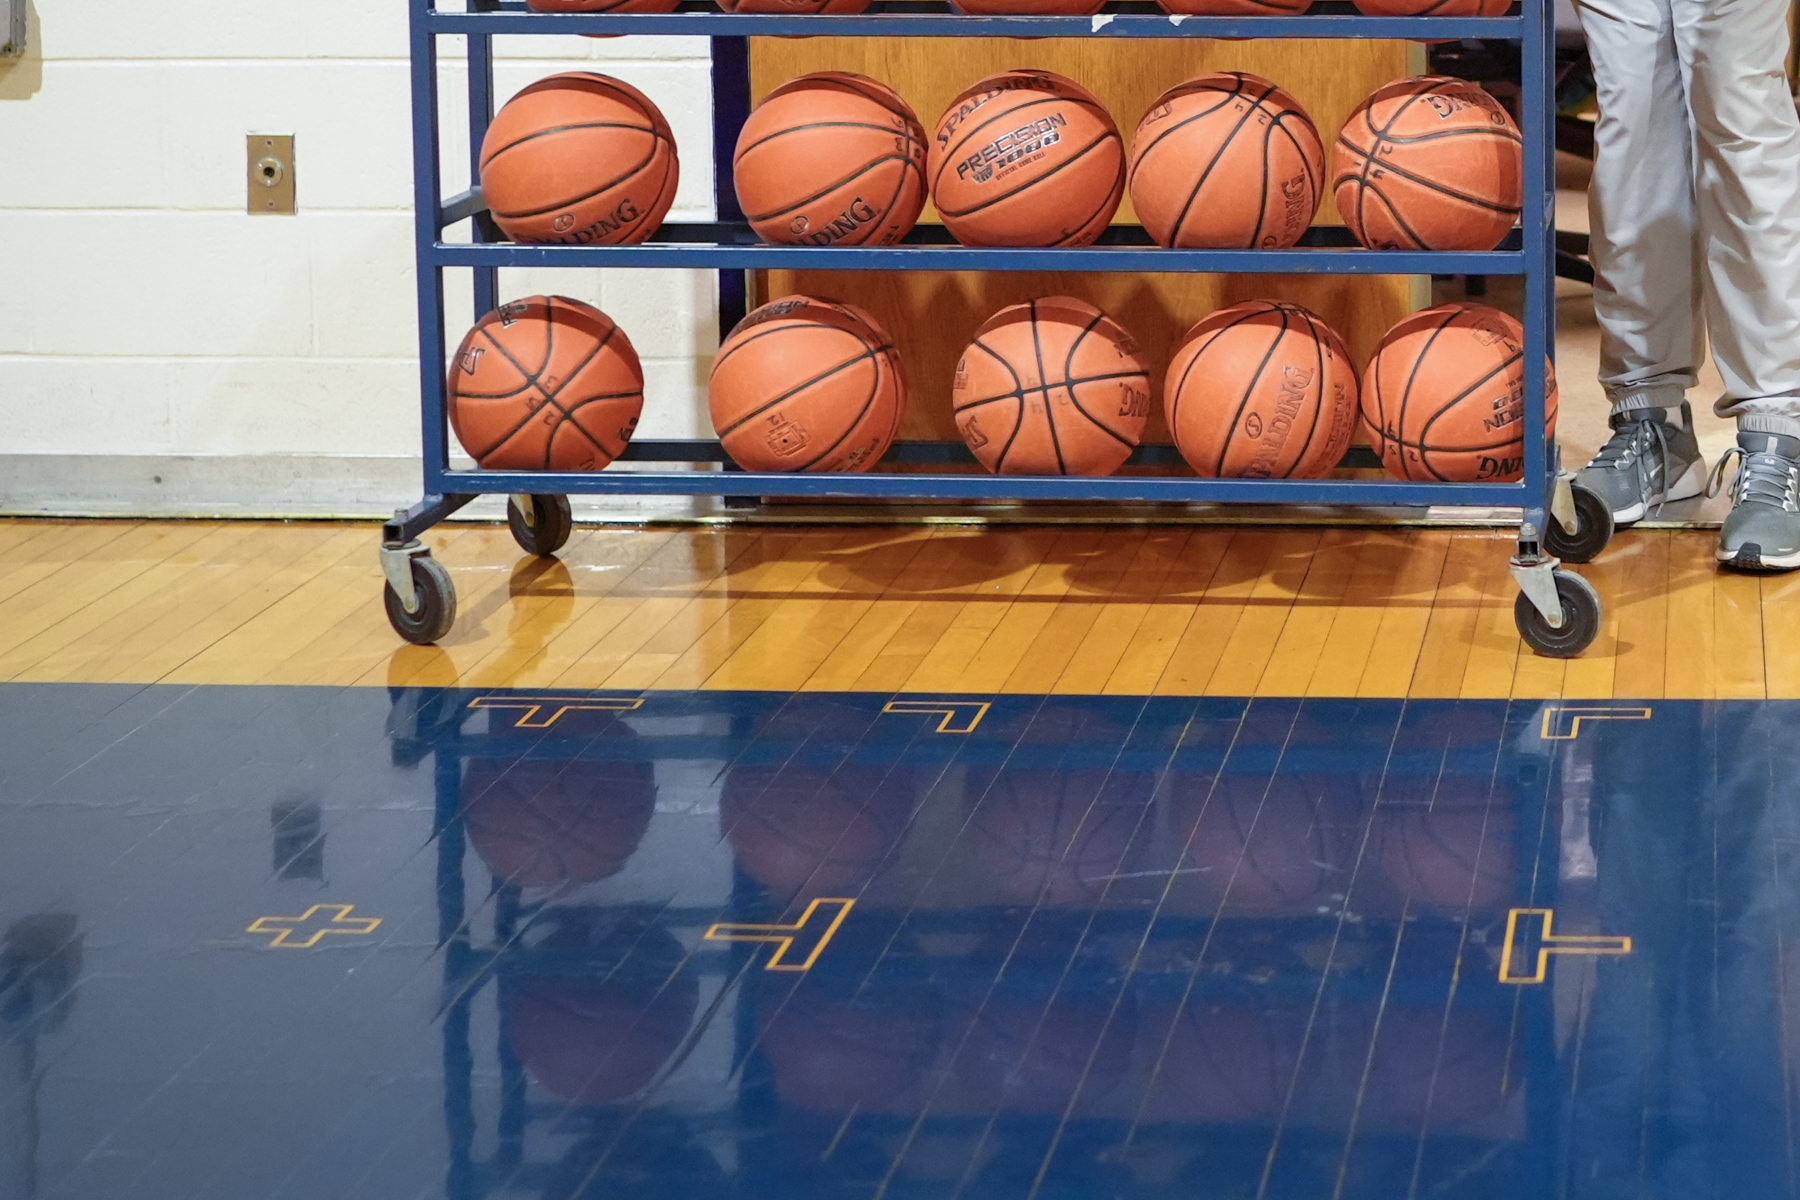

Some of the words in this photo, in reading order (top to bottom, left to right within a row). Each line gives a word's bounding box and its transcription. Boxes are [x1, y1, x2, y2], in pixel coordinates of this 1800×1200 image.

[936, 75, 1056, 152] SPALDING
[955, 112, 1067, 181] PRECISION
[995, 165, 1019, 181] OFFICIAL
[1033, 151, 1046, 163] BALL
[997, 132, 1061, 170] 1000
